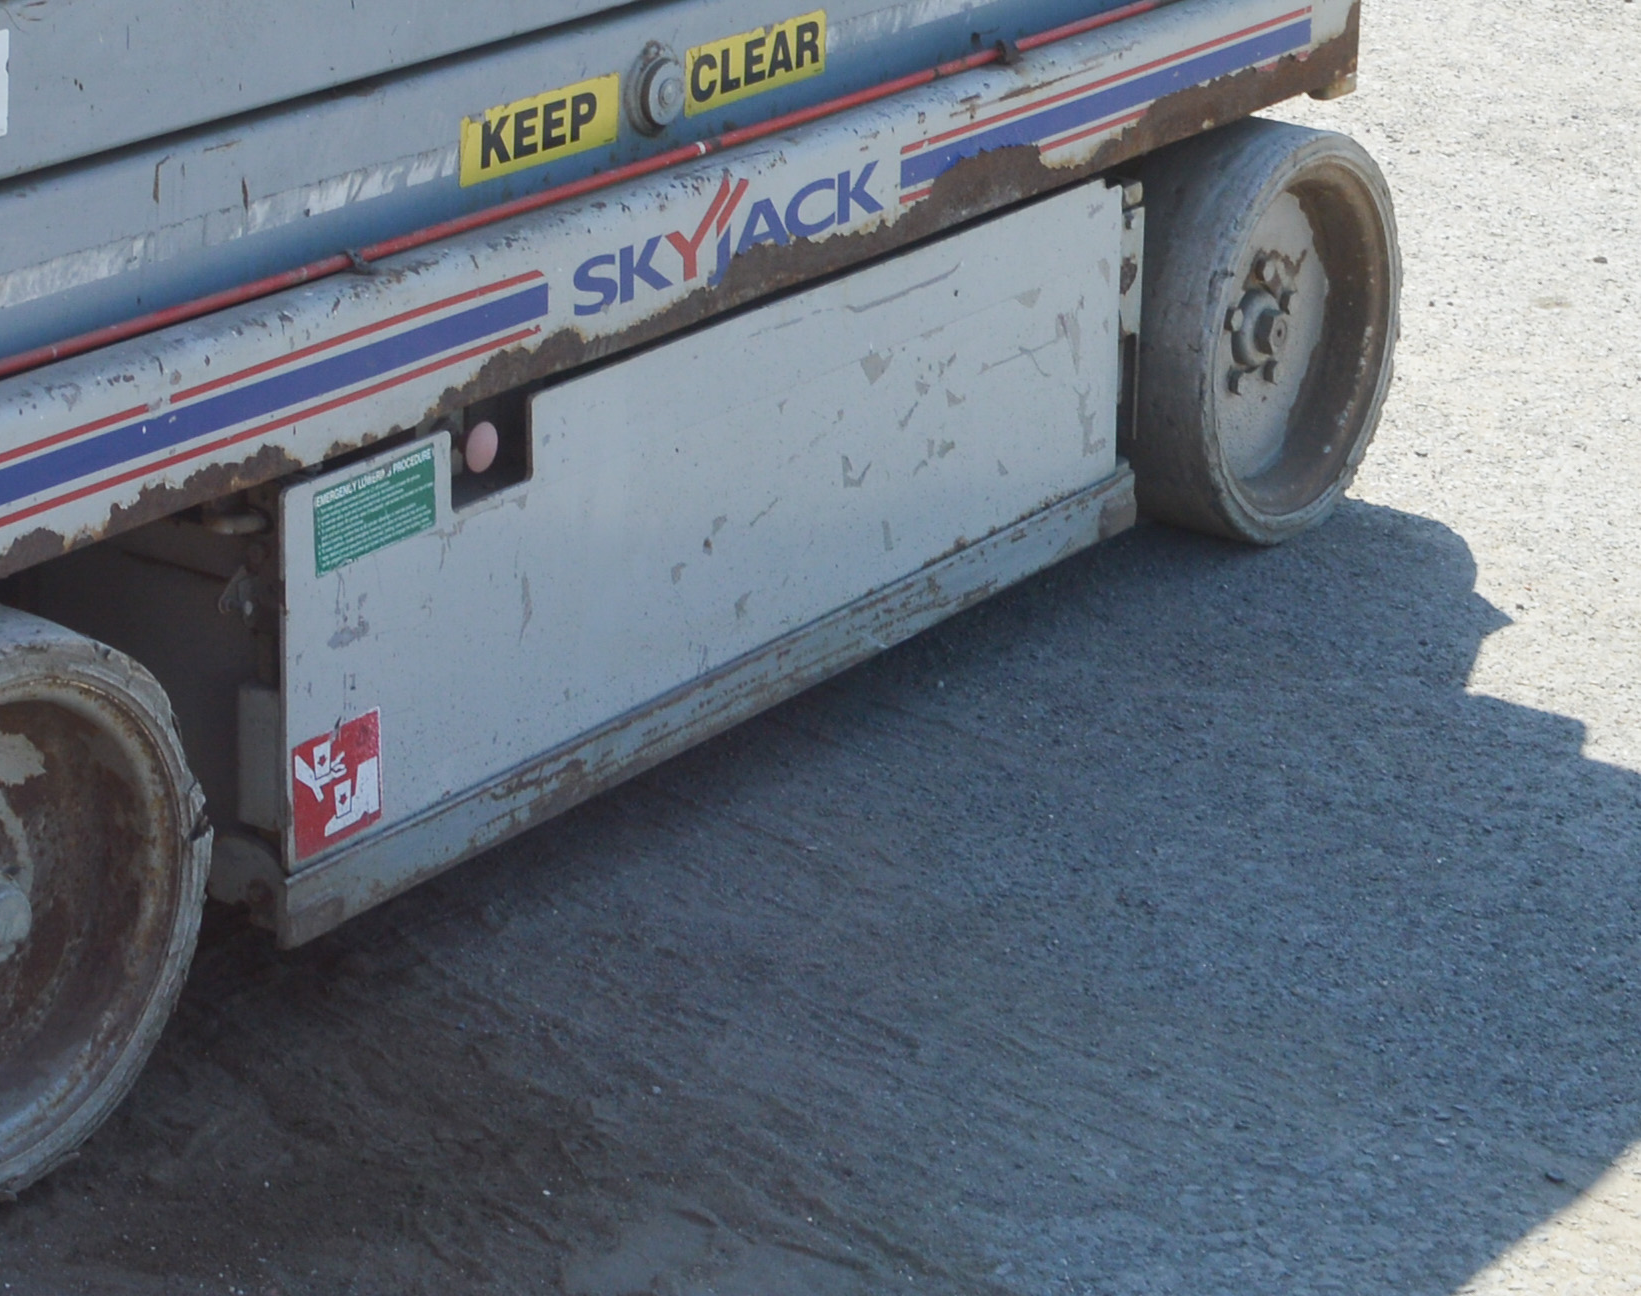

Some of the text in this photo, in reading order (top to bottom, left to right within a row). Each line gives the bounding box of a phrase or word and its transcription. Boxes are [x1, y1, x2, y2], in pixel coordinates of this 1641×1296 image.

[480, 20, 820, 169] KEEP CLEAR
[573, 160, 884, 316] SKYJACK
[316, 482, 357, 508] EMERGENCY
[393, 448, 431, 474] PROCEDURE
